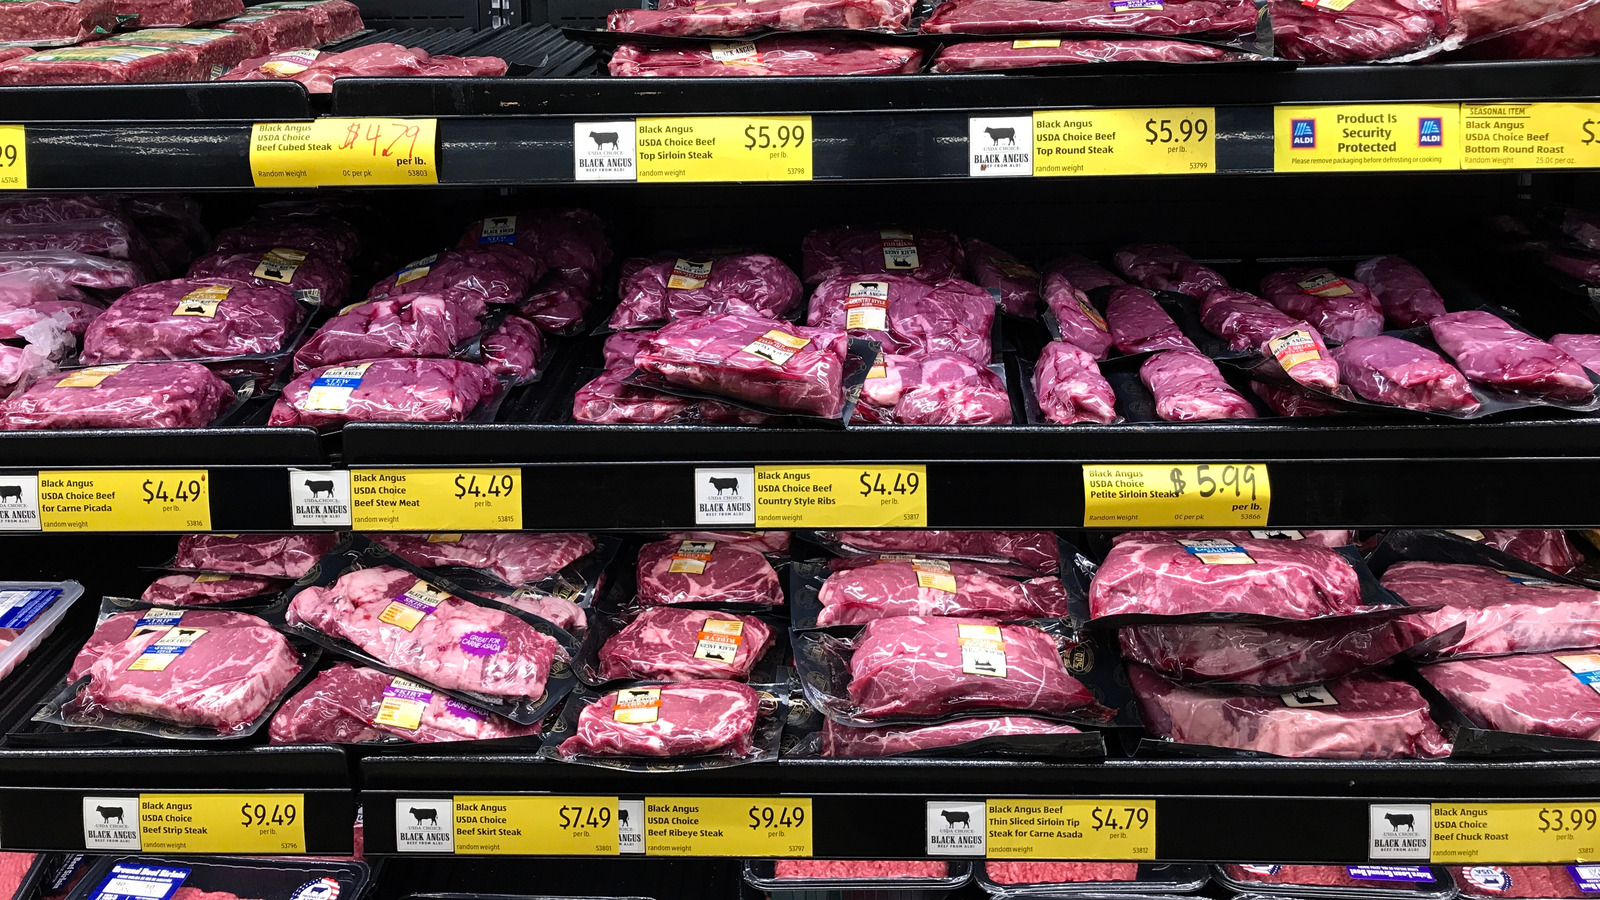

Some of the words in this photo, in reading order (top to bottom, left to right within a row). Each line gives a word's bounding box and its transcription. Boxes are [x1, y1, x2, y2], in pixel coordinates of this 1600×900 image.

[1337, 113, 1384, 123] Product
[1388, 114, 1397, 123] Is
[285, 125, 311, 133] Angus
[1037, 120, 1061, 128] Black
[1063, 120, 1092, 129] Angus
[1466, 121, 1491, 129] Black
[1493, 121, 1524, 131] Angus
[639, 125, 662, 133] Black
[665, 126, 693, 135] Angus
[1145, 118, 1208, 145] $5.99
[1343, 127, 1392, 140] Security
[664, 138, 693, 146] Choice
[696, 137, 715, 146] Beef
[745, 124, 804, 151] $5.99
[1037, 134, 1060, 142] USDA
[1063, 133, 1092, 141] Choice
[1095, 132, 1116, 140] Beef
[1466, 133, 1490, 141] USDA
[1493, 133, 1524, 141] Choice
[1527, 133, 1549, 141] Beef
[278, 143, 305, 151] Cubed
[308, 143, 332, 151] Steak
[1036, 147, 1053, 157] Top
[1055, 146, 1085, 154] Round
[1088, 145, 1114, 154] Steak
[1338, 141, 1396, 152] Protected
[1503, 145, 1534, 153] Round
[639, 152, 655, 161] Top
[657, 151, 686, 159] Sirloin
[688, 151, 713, 159] Steak
[974, 154, 1000, 164] BLACK
[1003, 153, 1028, 163] ANGUS
[396, 157, 412, 167] per
[414, 156, 426, 165] lb.
[579, 158, 604, 168] BLACK
[607, 158, 632, 167] ANGUS
[285, 170, 307, 178] Weight
[379, 474, 406, 483] Angus
[758, 472, 781, 480] Black
[783, 472, 810, 481] Angus
[1115, 470, 1143, 479] Angus
[67, 480, 93, 489] Angus
[454, 474, 513, 500] $4.49
[860, 471, 919, 497] $4.49
[1170, 464, 1256, 501] $5.99
[142, 479, 200, 504] $4.49
[378, 486, 406, 494] Choice
[782, 484, 811, 492] Choice
[813, 484, 832, 492] Beef
[41, 492, 64, 500] USDA
[66, 491, 94, 500] Choice
[96, 491, 115, 499] Beef
[1091, 490, 1117, 498] Petite
[1119, 490, 1148, 498] Sirloin
[354, 499, 374, 507] Beef
[376, 499, 397, 507] Stew
[399, 499, 420, 507] Meat
[758, 497, 792, 507] Country
[794, 497, 815, 506] Style
[817, 496, 836, 505] Ribs
[84, 504, 112, 512] Picada
[700, 503, 724, 512] BLACK
[726, 502, 751, 512] ANGUS
[1232, 503, 1247, 512] per
[1250, 502, 1262, 511] lb.
[404, 597, 428, 608] SKIRT
[470, 635, 484, 643] GREAT
[462, 638, 481, 648] CARNE
[481, 644, 500, 652] ASADA
[394, 688, 424, 698] SKIRT
[448, 700, 467, 710] CARNE
[469, 706, 489, 716] ASADA
[166, 802, 192, 811] Angus
[480, 804, 507, 813] Angus
[648, 804, 670, 812] Black
[672, 805, 699, 814] Angus
[1014, 806, 1041, 815] Angus
[1043, 806, 1063, 814] Beef
[165, 814, 192, 822] Choice
[241, 802, 296, 827] $9.49
[559, 805, 611, 830] $7.49
[749, 805, 804, 830] $9.49
[1434, 808, 1458, 816] Black
[1460, 809, 1488, 818] Angus
[648, 817, 670, 825] USDA
[671, 816, 699, 825] Choice
[1009, 817, 1035, 825] Sliced
[1037, 818, 1065, 826] Sirloin
[1067, 818, 1080, 828] Tip
[1092, 806, 1149, 831] $4.79
[1538, 808, 1597, 833] $3.99
[1434, 820, 1457, 828] USDA
[1459, 820, 1487, 828] Choice
[163, 827, 182, 835] Strip
[498, 828, 521, 836] Steak
[669, 829, 698, 838] Ribeye
[700, 829, 723, 837] Steak
[1015, 829, 1027, 837] for
[1029, 830, 1054, 838] Carne
[1056, 830, 1083, 838] Asada
[931, 836, 956, 844] BLACK
[958, 836, 982, 844] ANGUS
[1434, 833, 1454, 841] Beef
